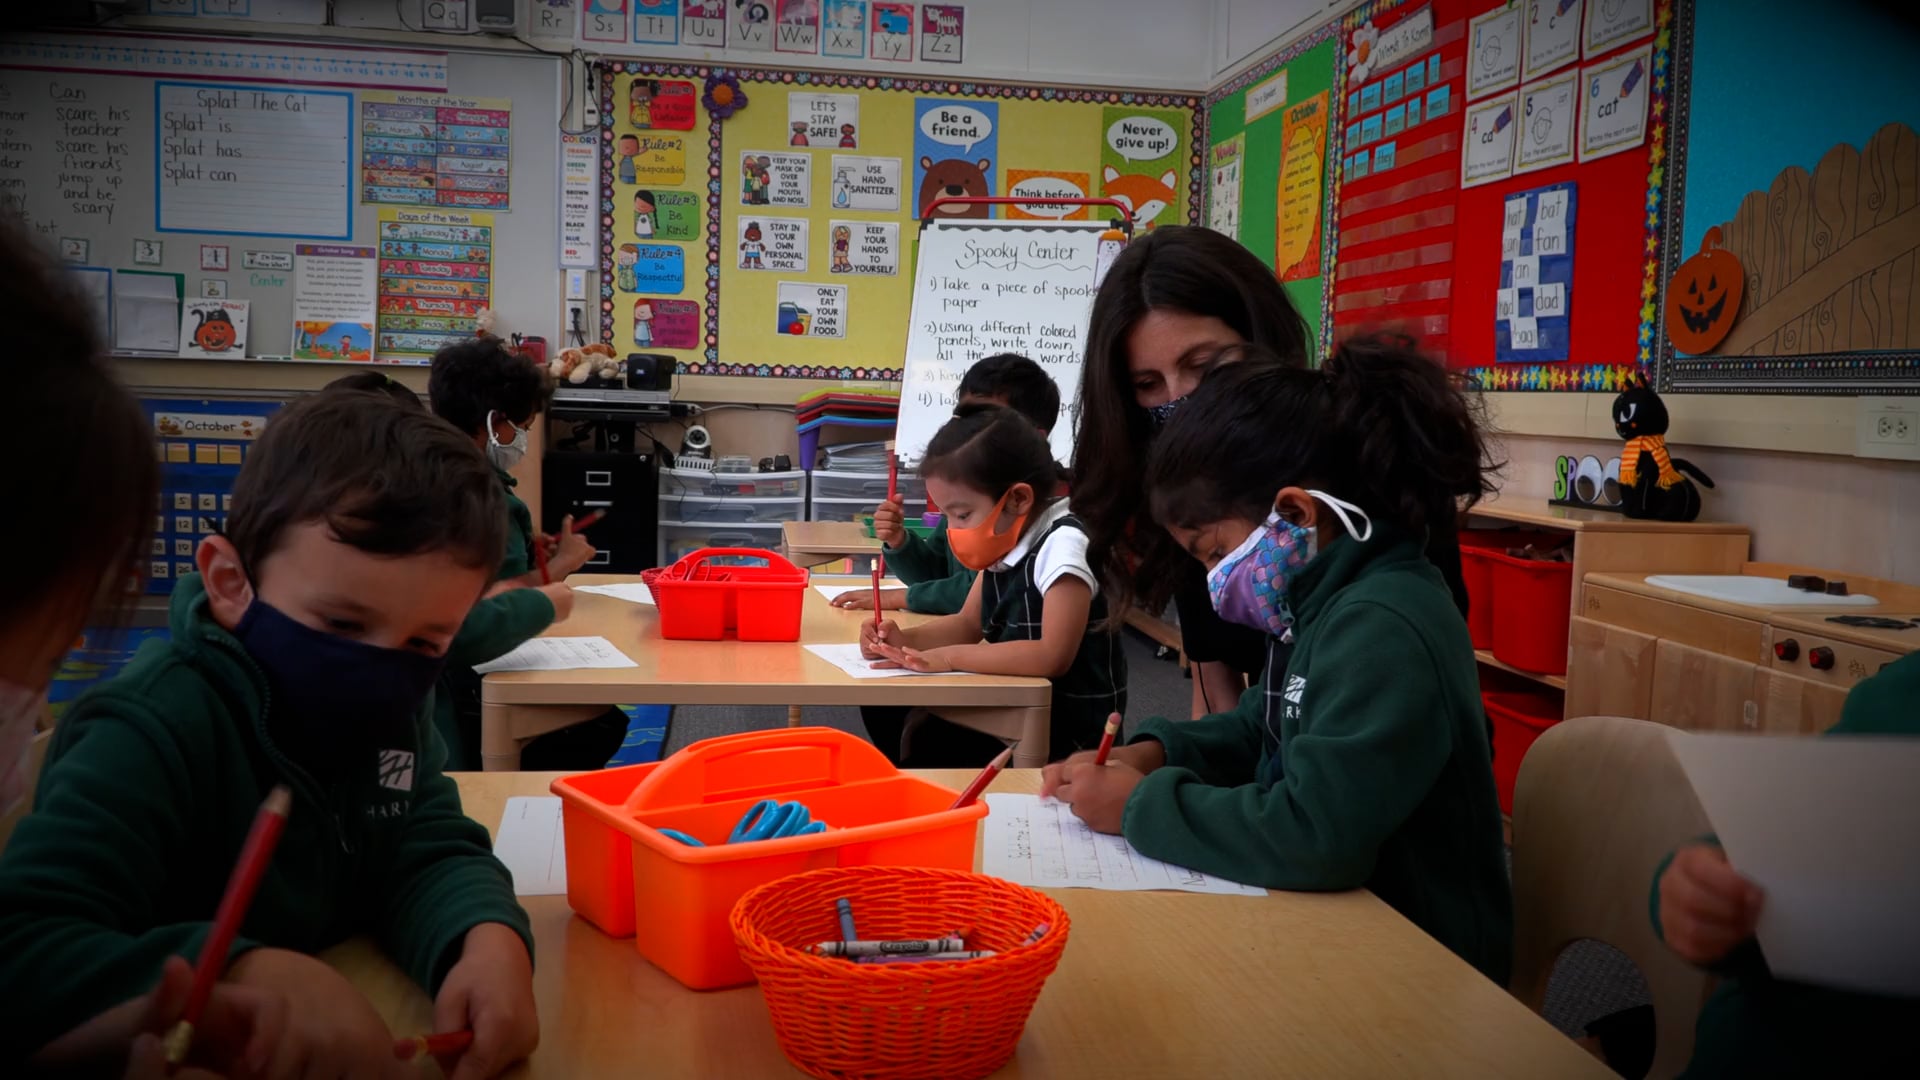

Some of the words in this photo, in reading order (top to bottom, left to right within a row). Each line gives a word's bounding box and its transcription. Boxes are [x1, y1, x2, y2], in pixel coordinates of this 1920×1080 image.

[50, 81, 87, 99] Can
[1591, 78, 1599, 97] 6
[197, 89, 238, 115] Splat
[251, 92, 279, 109] The
[284, 94, 307, 112] Cat
[397, 96, 429, 106] Months
[431, 96, 442, 105] of
[444, 97, 457, 107] the
[811, 101, 836, 112] LET'S
[1526, 97, 1533, 116] 5
[56, 107, 98, 121] scare
[109, 105, 130, 121] his
[1598, 97, 1619, 118] cat
[811, 115, 836, 125] STAY
[940, 111, 958, 124] Be
[962, 115, 972, 124] a
[64, 122, 122, 137] teacher
[164, 112, 204, 138] Splat
[219, 118, 232, 134] is
[1122, 123, 1164, 136] Never
[810, 127, 837, 138] SAFE!
[932, 124, 981, 139] friend.
[562, 135, 598, 145] COLORS
[1115, 137, 1145, 149] give
[1148, 138, 1169, 152] up!
[56, 139, 99, 153] scare
[106, 139, 128, 155] his
[163, 136, 204, 163] Splat
[216, 139, 243, 159] has
[64, 154, 122, 171] friends
[773, 157, 787, 165] KEEP
[164, 161, 204, 188] Splat
[209, 169, 238, 183] can
[866, 165, 882, 174] USE
[57, 173, 94, 190] jump
[106, 174, 123, 189] up
[861, 175, 886, 184] HAND
[64, 187, 89, 199] and
[850, 185, 897, 196] SANITIZER.
[1015, 188, 1042, 199] Think
[1044, 189, 1080, 199] before
[72, 202, 115, 224] scary
[398, 212, 419, 222] Days
[420, 213, 431, 221] of
[433, 213, 447, 222] the
[448, 215, 470, 223] Week
[668, 210, 683, 220] Be
[666, 225, 689, 236] Kind
[770, 223, 789, 232] STAY
[791, 224, 800, 232] IN
[866, 226, 884, 234] KEEP
[774, 233, 796, 241] YOUR
[864, 235, 887, 244] YOUR
[1536, 227, 1560, 252] fan
[775, 242, 794, 250] OWN
[861, 245, 889, 254] HANDS
[765, 251, 804, 260] PERSONAL
[869, 255, 881, 263] TO
[964, 239, 1019, 271] Spooky
[1028, 240, 1079, 261] Center
[817, 288, 839, 296] ONLY
[940, 277, 970, 291] Take
[981, 282, 989, 291] a
[997, 281, 1028, 297] piece
[1033, 280, 1048, 294] of
[820, 298, 835, 306] EAT
[943, 297, 981, 313] paper
[816, 308, 838, 316] YOUR
[817, 317, 837, 326] OWN
[814, 326, 839, 335] FOOD.
[939, 322, 973, 340] Using
[981, 320, 1031, 336] different
[1040, 323, 1076, 339] colored
[991, 336, 1027, 348] write
[1035, 337, 1073, 350] down
[936, 349, 953, 361] all
[966, 350, 985, 360] the
[1040, 351, 1081, 364] words
[184, 419, 237, 432] October
[203, 498, 210, 506] 6
[178, 521, 189, 529] 12
